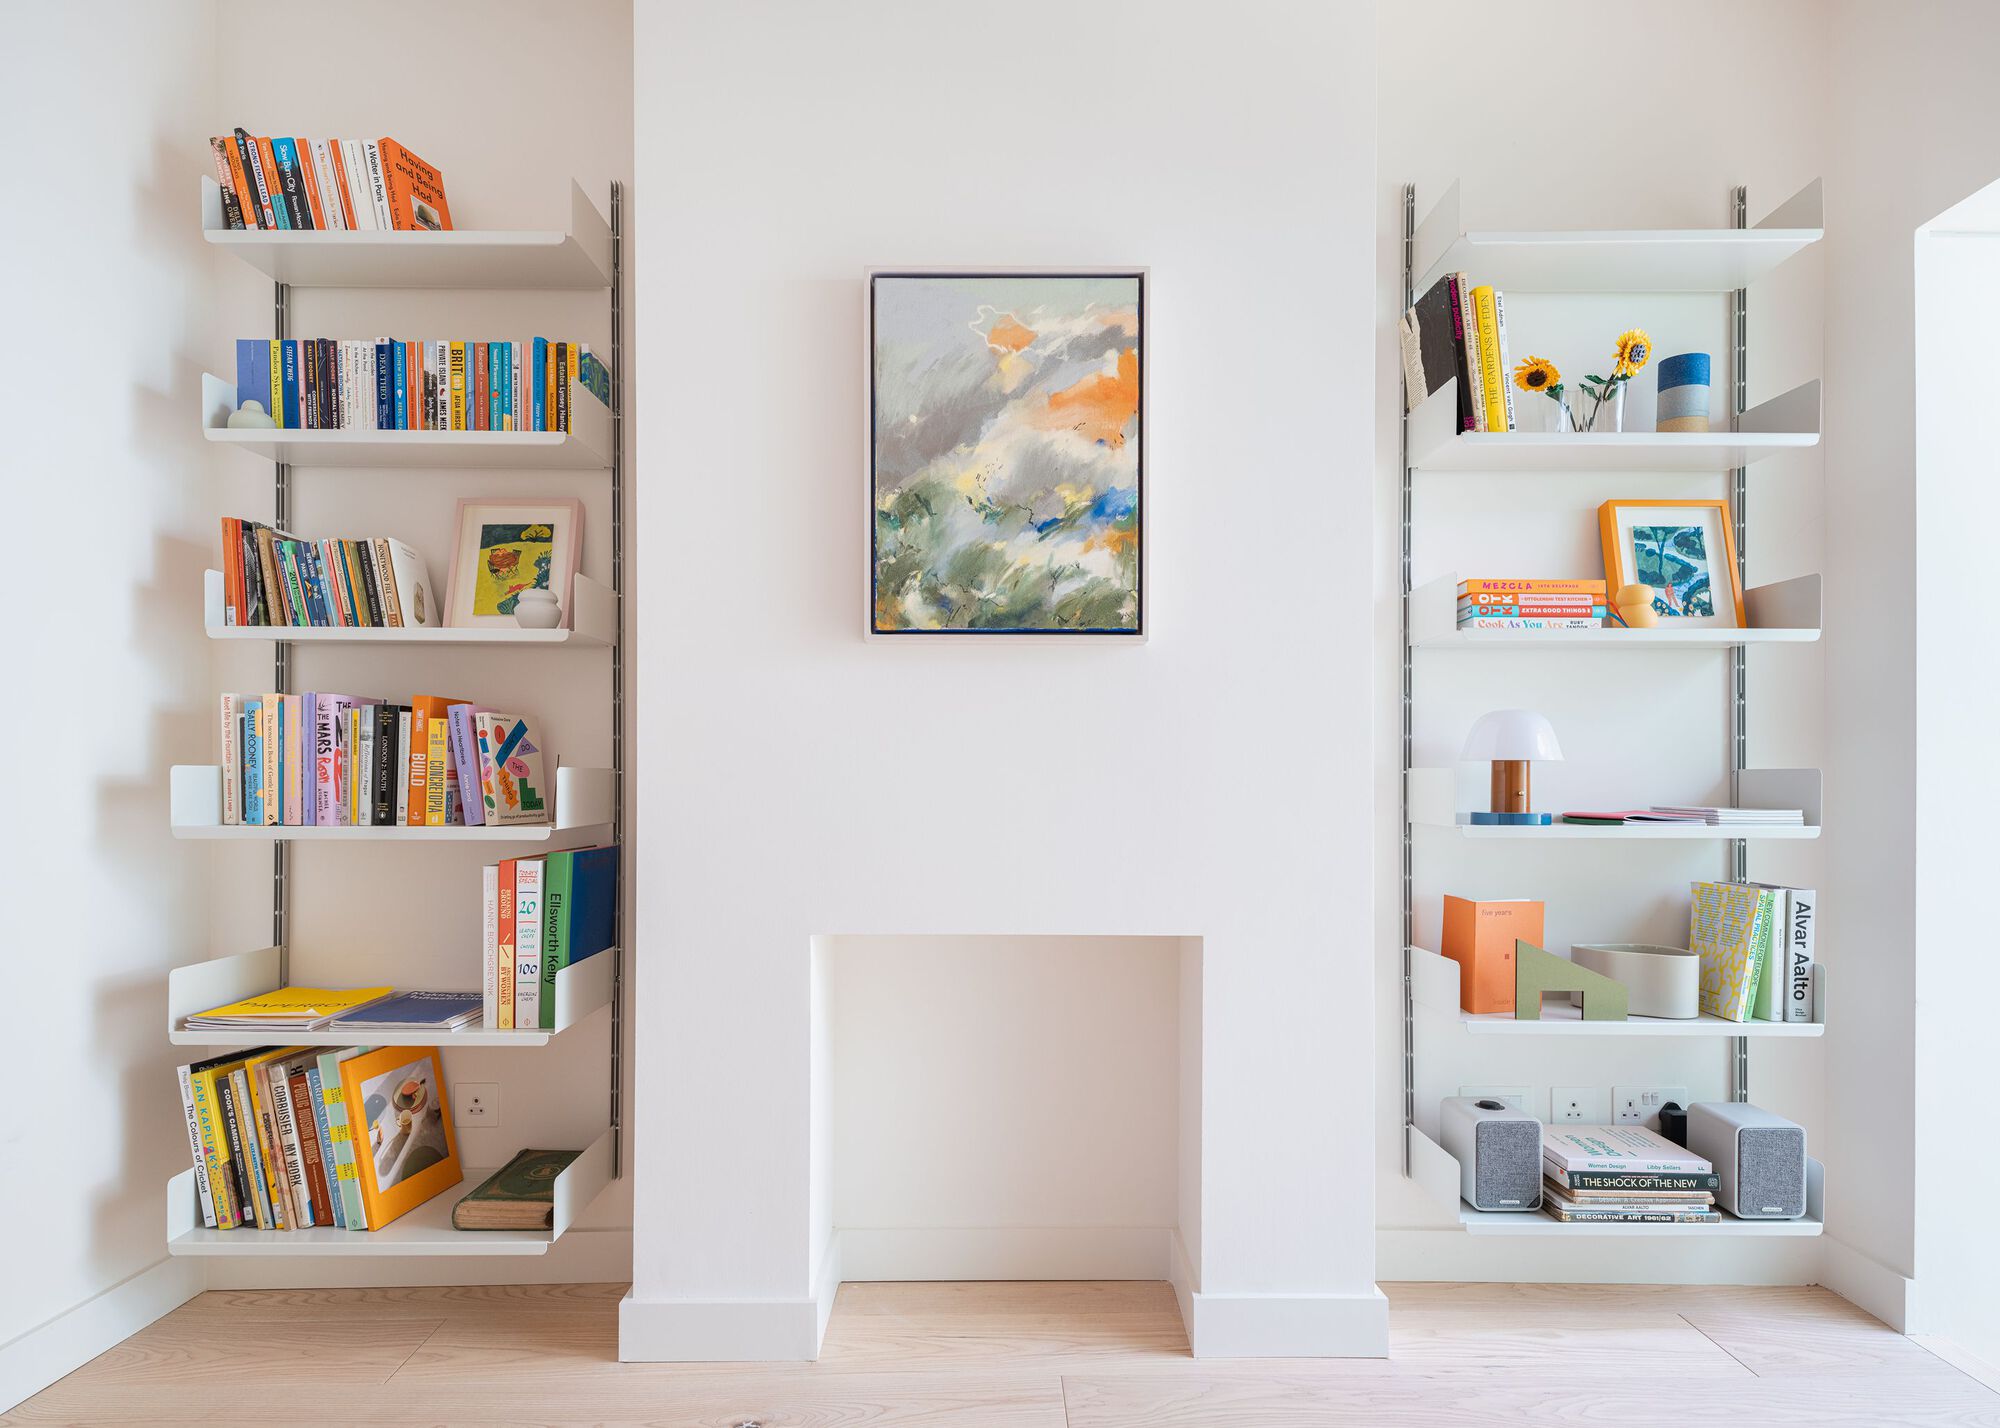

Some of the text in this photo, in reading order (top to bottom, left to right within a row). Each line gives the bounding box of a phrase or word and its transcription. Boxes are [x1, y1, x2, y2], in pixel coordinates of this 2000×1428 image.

[239, 146, 247, 160] Paris
[279, 144, 289, 161] Slow
[369, 151, 379, 176] Waiter
[399, 148, 434, 181] Having
[248, 141, 257, 165] STRONG
[253, 165, 264, 188] FEMALE
[259, 188, 269, 204] LEAD
[283, 161, 294, 178] Burn
[373, 176, 381, 184] in
[396, 162, 443, 200] and Being
[221, 188, 231, 204] SING
[285, 178, 296, 193] City
[374, 184, 384, 203] Paris
[412, 182, 433, 204] Had
[291, 196, 300, 212] Rowan
[1461, 278, 1470, 316] DECORATIVE
[1449, 307, 1463, 340] publicity
[272, 346, 280, 374] Pandora
[286, 345, 294, 363] STEFAN
[1480, 294, 1499, 407] THE GARDENS OF EDEN
[271, 375, 281, 395] Sykes
[286, 364, 295, 382] ZWEIG
[1504, 372, 1512, 397] Vincent
[438, 345, 447, 431] PRIVATE ISLAND JAMES MEEK
[558, 387, 566, 409] Lynsey
[454, 394, 462, 409] AFUA
[558, 409, 566, 433] Hanley
[1506, 407, 1514, 422] Gogh
[305, 552, 316, 578] NEW YORK
[384, 583, 392, 594] FILE
[1483, 582, 1532, 590] MEZCLA
[1478, 620, 1563, 629] Cook As You Are
[223, 696, 231, 711] Meet
[336, 701, 352, 713] THE
[224, 713, 231, 721] Me
[247, 709, 257, 769] SALLY ROONEY
[317, 722, 332, 755] MARS
[225, 740, 233, 764] Fountain
[457, 736, 467, 766] Heartbreak
[411, 753, 427, 787] BUILD
[511, 761, 524, 773] THE
[267, 789, 275, 807] Living
[428, 760, 445, 813] CONCRETOPIA
[487, 900, 495, 930] HANNE
[518, 900, 537, 915] 20
[1494, 910, 1512, 918] years
[544, 892, 562, 985] Ellsworth Kelly
[1748, 894, 1766, 961] SPATIAL PRACTICES
[1751, 899, 1774, 987] NEW COMMONS FOR EUROPE
[1793, 901, 1811, 1001] Alvar Aalto
[500, 966, 506, 976] BY
[518, 963, 538, 975] 100
[194, 1079, 205, 1103] JAN
[223, 1088, 241, 1152] COOK'S CAMDEN
[293, 1083, 318, 1165] PUBLIC HOUSING WORKS
[312, 1075, 338, 1188] GARDENS UNDER BIG SKIES
[186, 1104, 208, 1194] The Colours of Cricket
[274, 1086, 302, 1188] CORBUSIER MY WORK
[1583, 1177, 1697, 1188] THE SHOCK OF THE NEW
